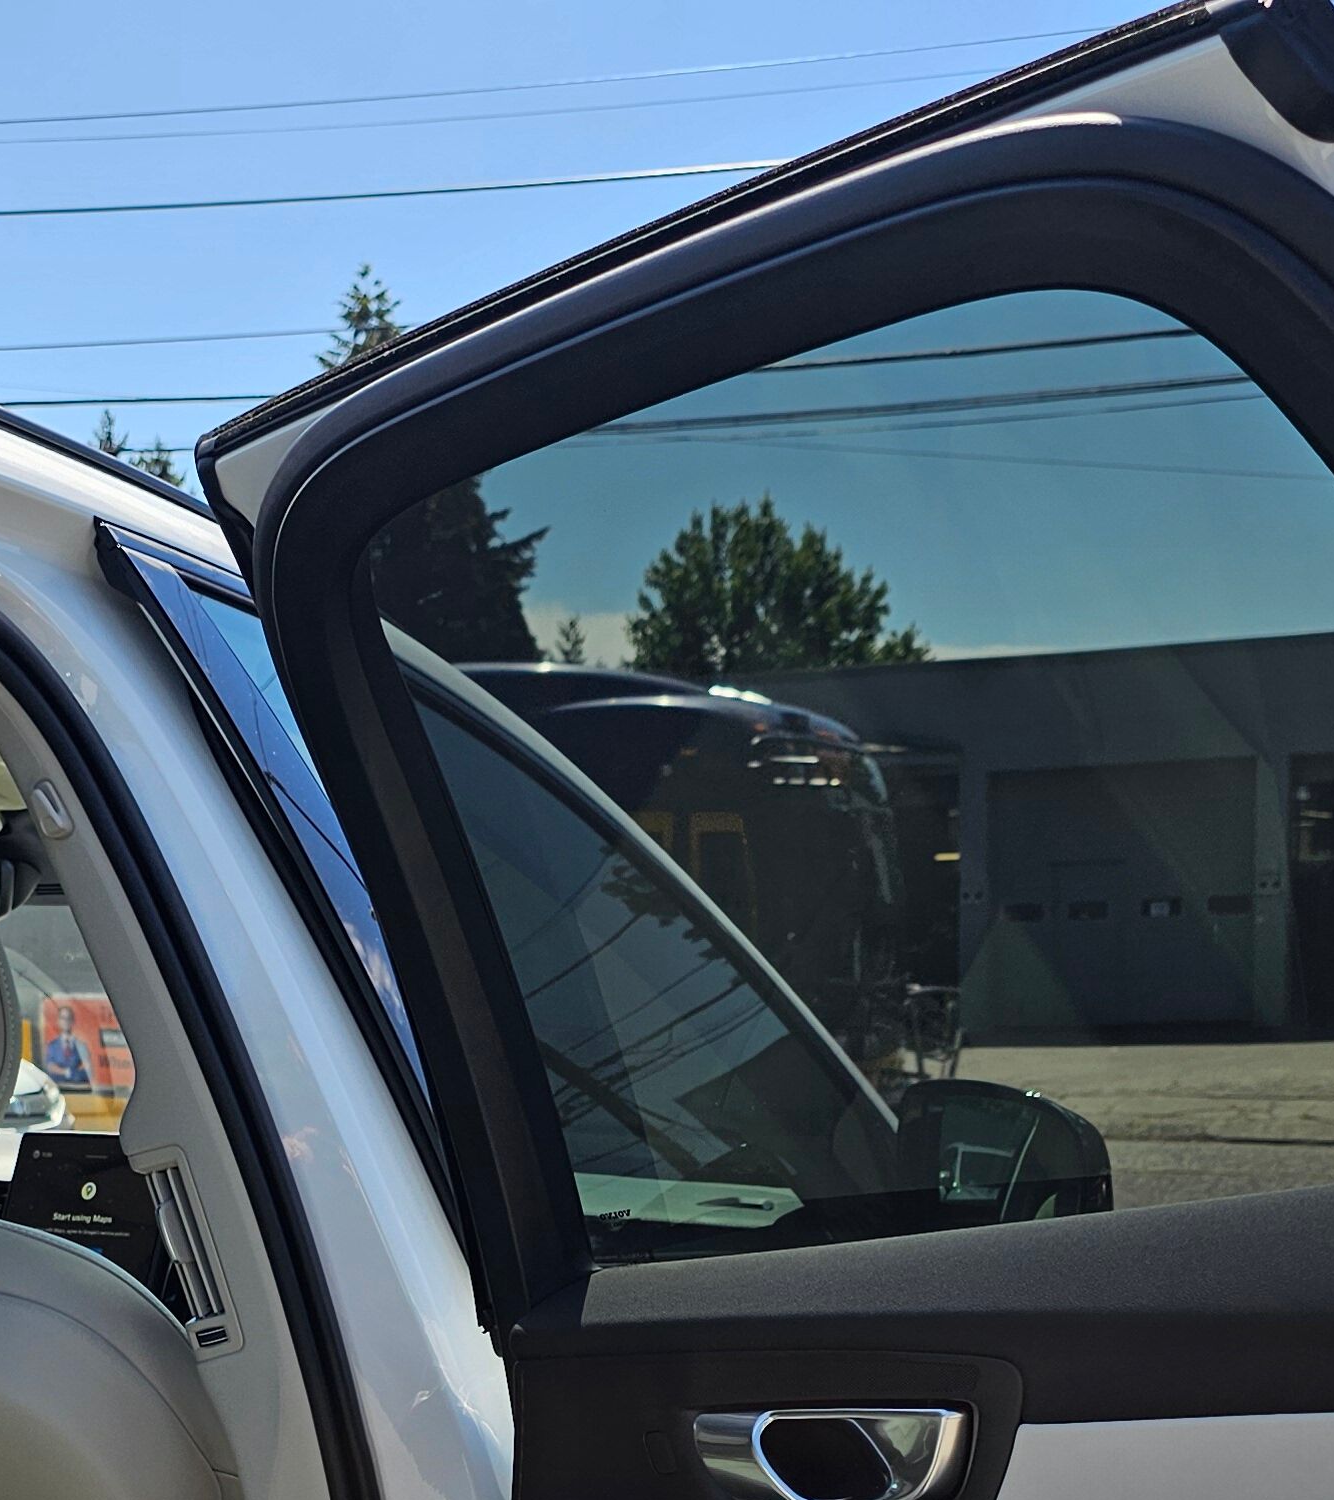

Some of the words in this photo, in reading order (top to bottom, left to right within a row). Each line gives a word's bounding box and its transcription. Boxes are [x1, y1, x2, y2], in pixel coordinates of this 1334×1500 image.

[53, 1212, 71, 1221] Start
[71, 1214, 91, 1224] using
[93, 1214, 113, 1224] Maps
